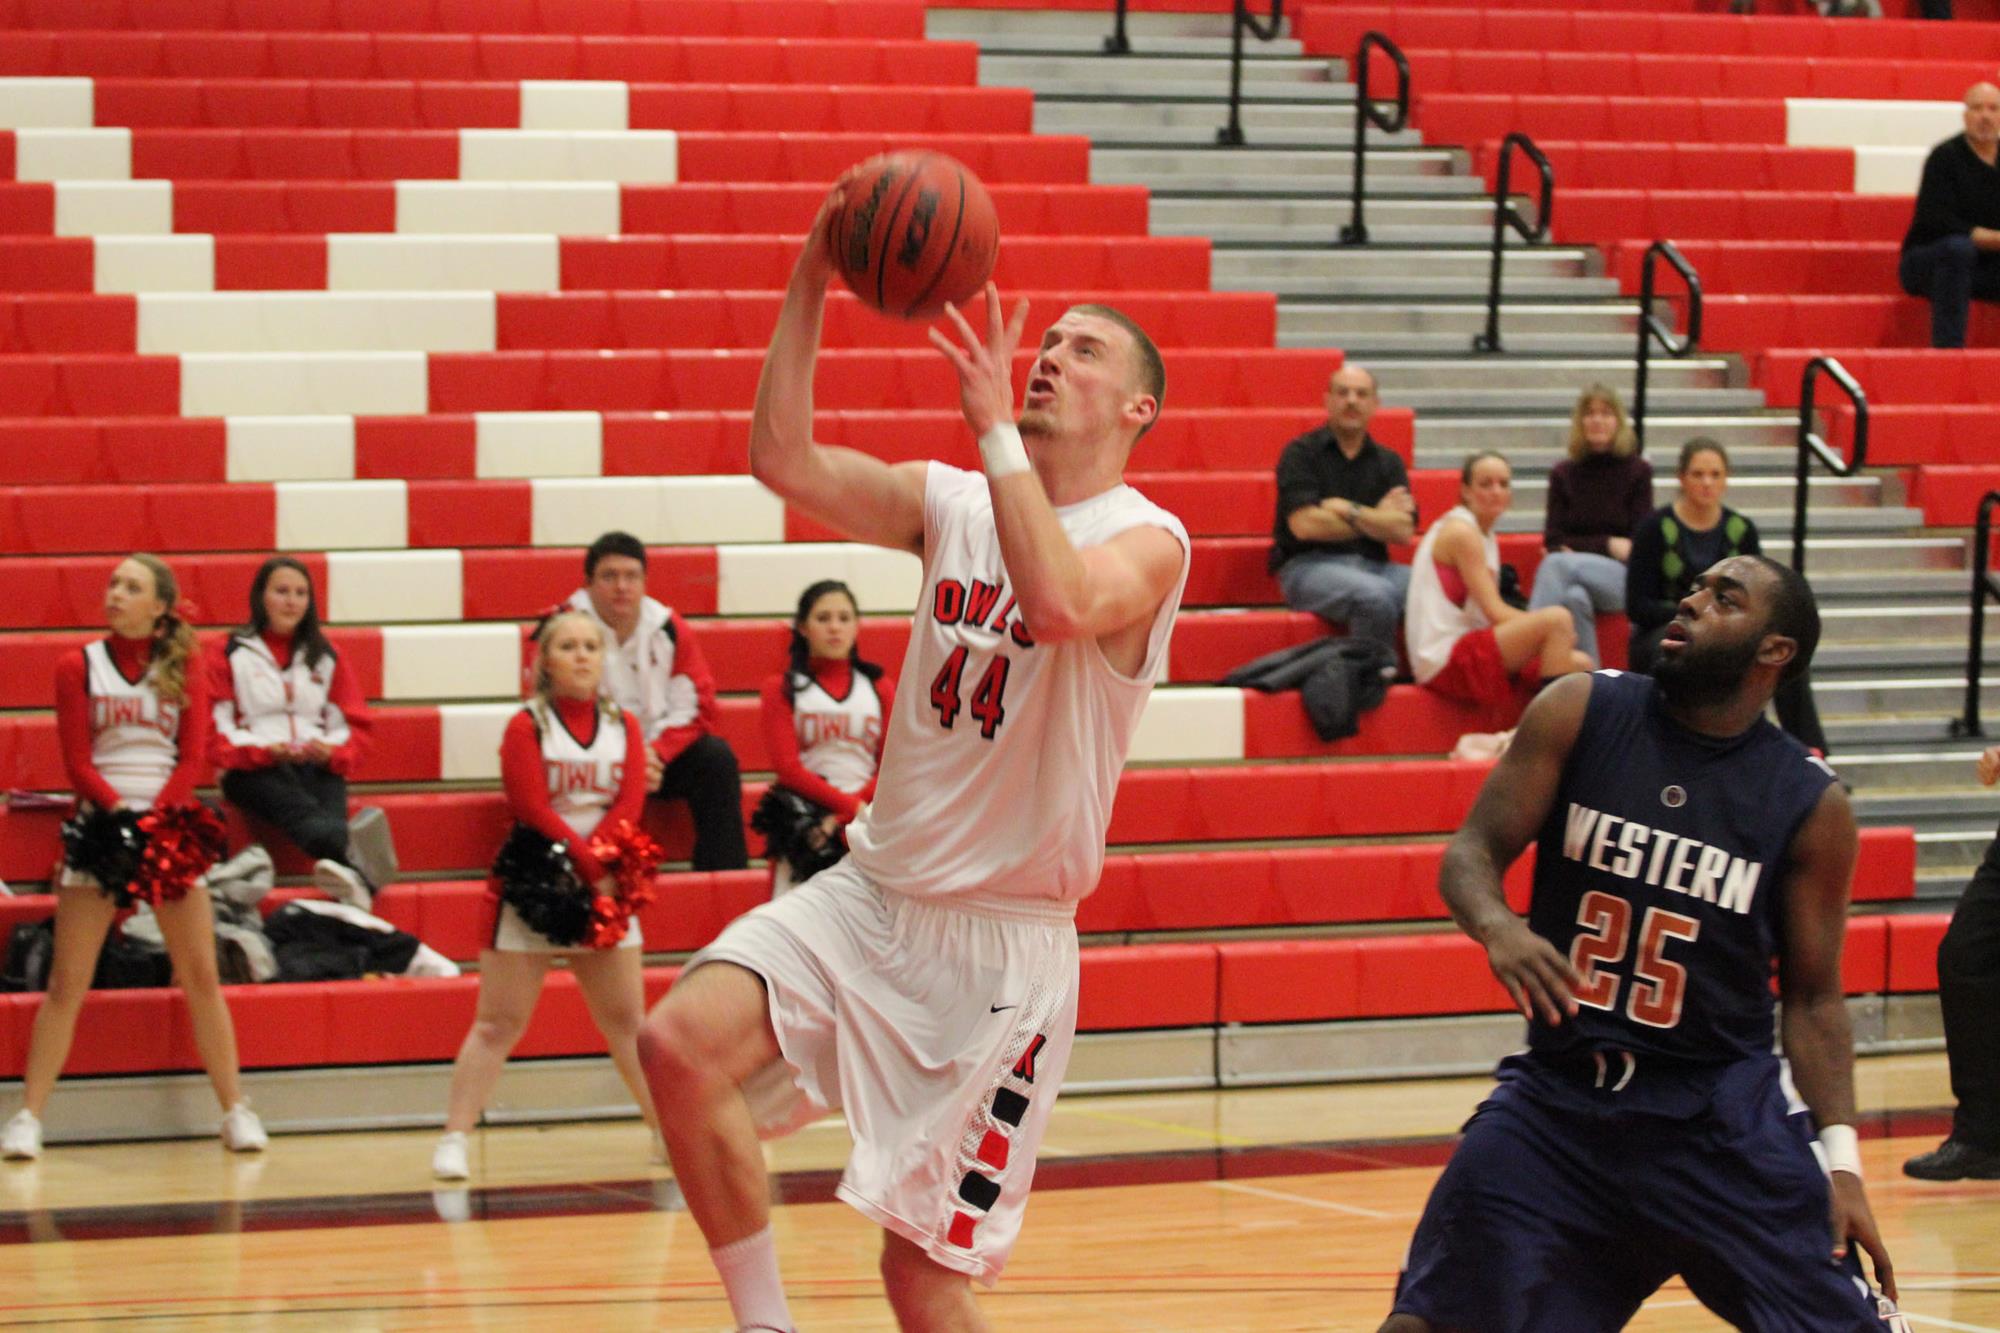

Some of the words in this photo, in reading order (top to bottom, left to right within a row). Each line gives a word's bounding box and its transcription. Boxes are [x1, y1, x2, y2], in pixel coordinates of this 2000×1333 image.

[88, 695, 179, 737] OWLS
[931, 644, 1010, 740] 44
[797, 712, 881, 753] OWLS
[543, 759, 624, 800] OWLS
[1562, 803, 1762, 914] WESTERN
[1568, 890, 1700, 1028] 25
